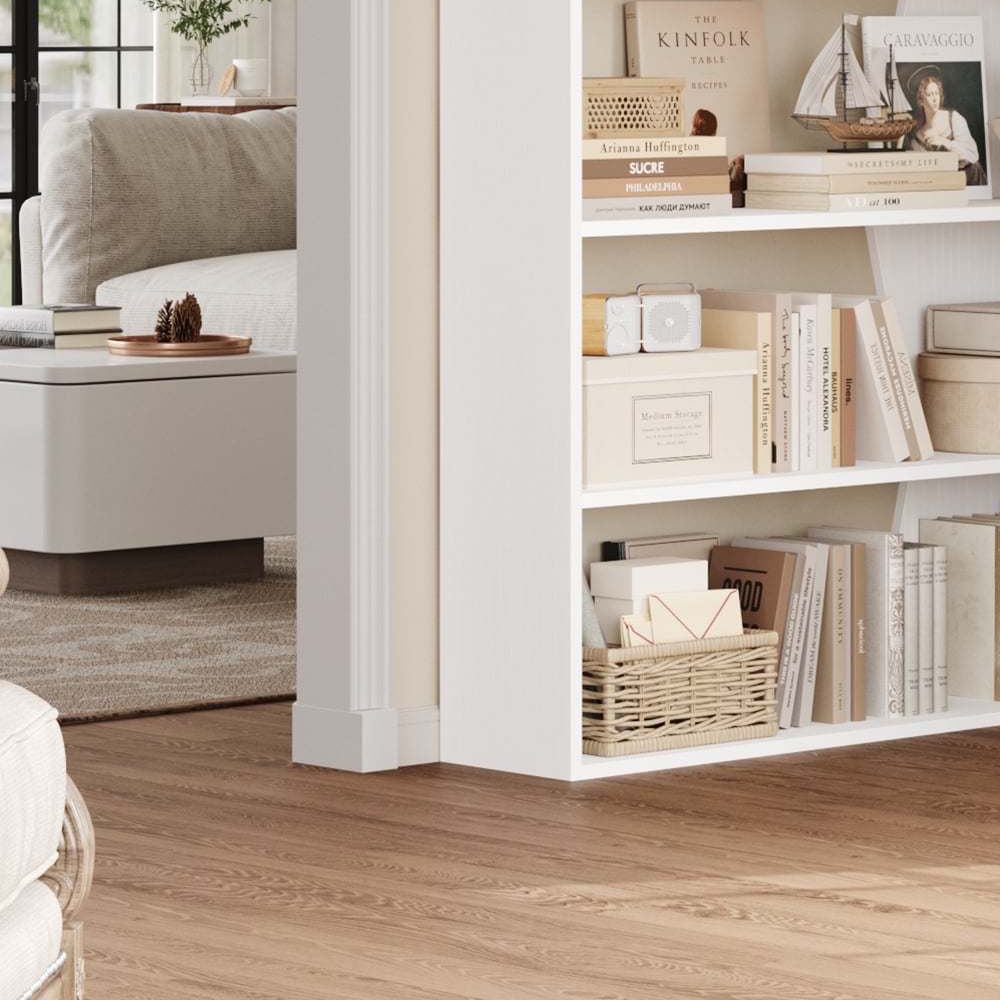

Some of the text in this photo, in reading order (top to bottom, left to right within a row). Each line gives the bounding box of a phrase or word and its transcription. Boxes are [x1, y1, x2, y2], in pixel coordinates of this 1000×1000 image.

[694, 15, 718, 25] THE
[657, 30, 751, 49] KINFOLK
[882, 31, 975, 48] CARAVAGGIO
[690, 55, 727, 65] TABLE
[691, 81, 729, 90] RECIPES
[599, 139, 700, 156] Arianna Huffington
[628, 160, 666, 176] SUCRE
[900, 159, 913, 168] MY
[917, 158, 938, 168] LIFE
[625, 181, 683, 194] PHILADELPHIA
[638, 204, 654, 213] КАК
[654, 203, 679, 213] ЛЮДИ
[678, 201, 711, 213] ДУМАЮТ
[868, 199, 880, 208] at
[883, 196, 902, 207] 100
[759, 341, 771, 447] Arianna Huffington
[822, 346, 830, 433] HOTEL ALEXANDRIA
[844, 377, 853, 407] lines.
[790, 591, 800, 620] GUIDE
[836, 567, 844, 645] ON IMMUNITY
[785, 620, 796, 648] GOOD
[857, 618, 866, 655] spherical
[784, 648, 792, 656] A
[779, 665, 789, 686] THIS
